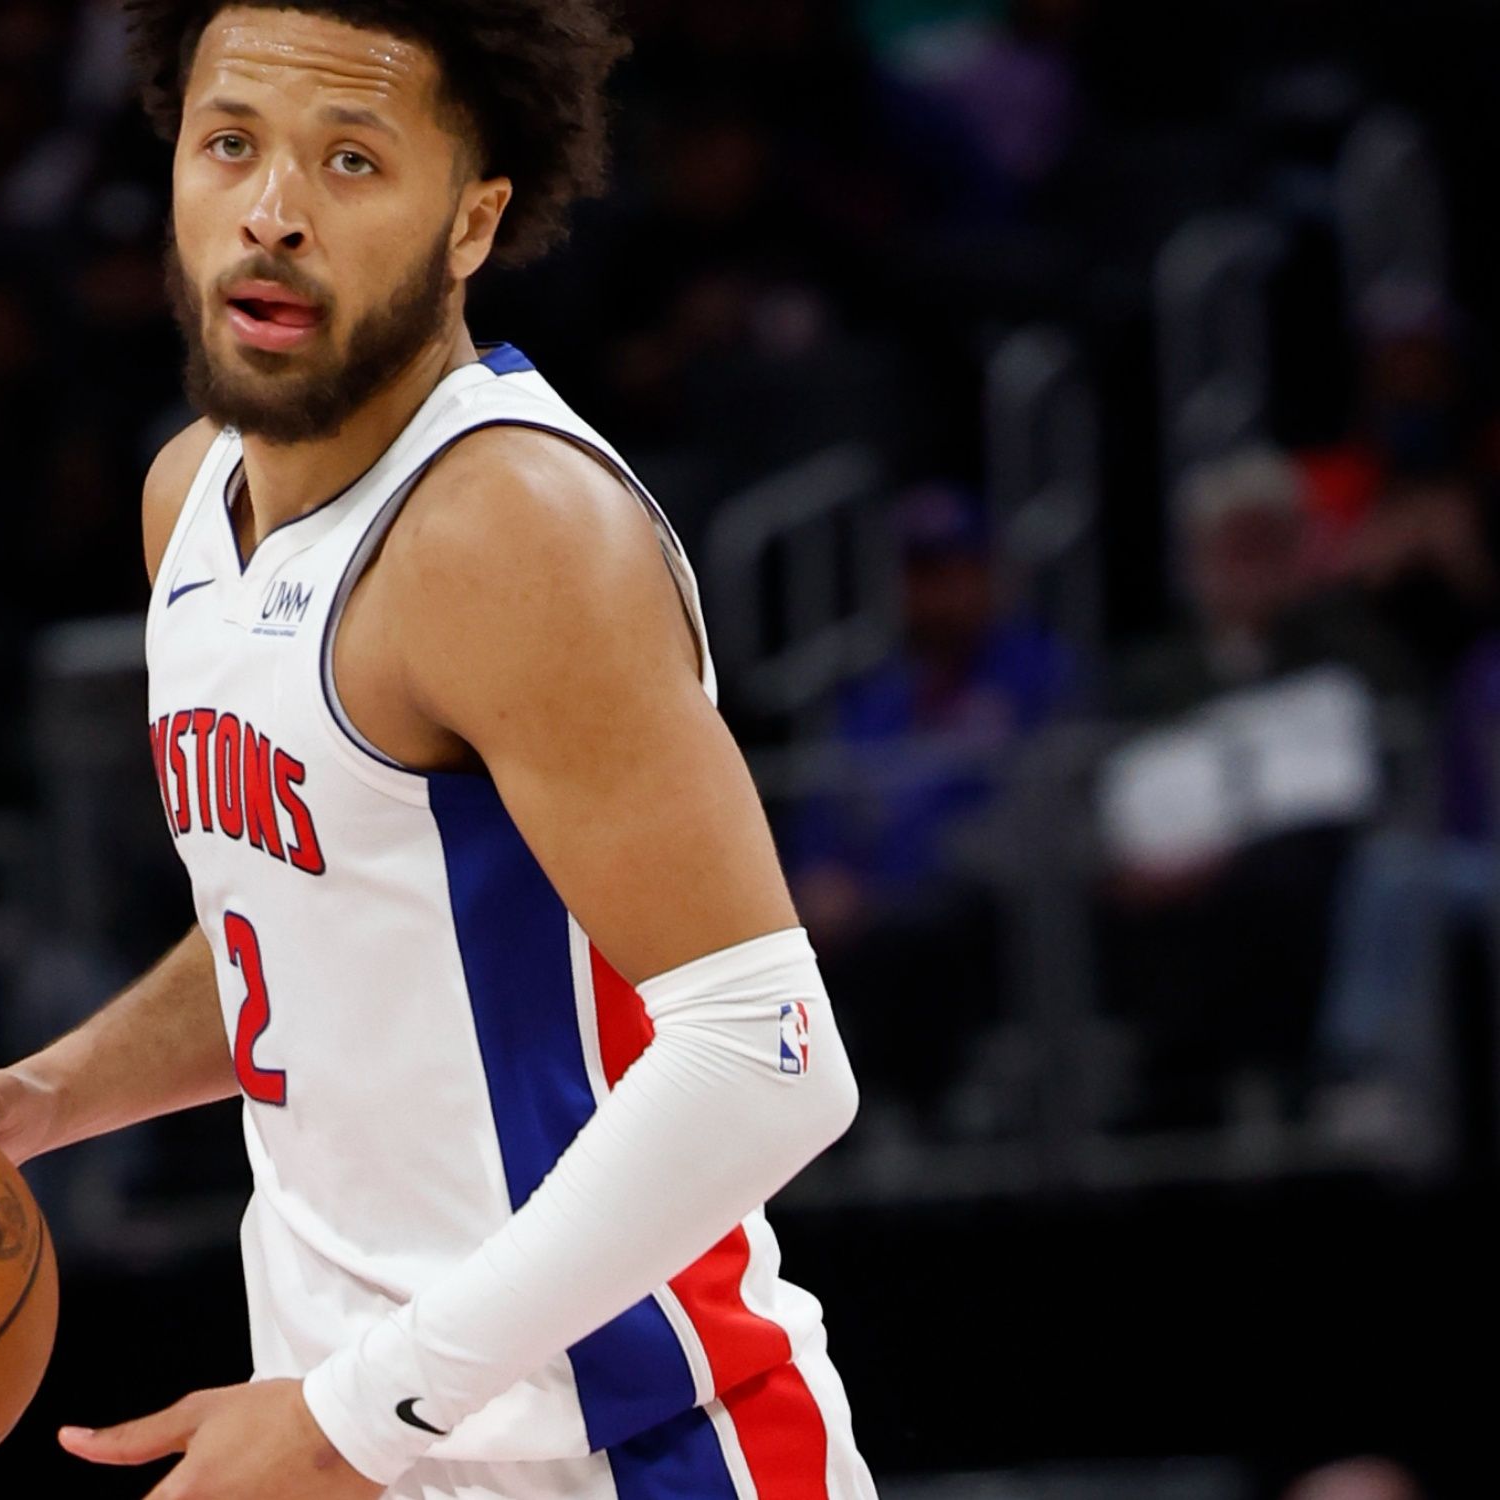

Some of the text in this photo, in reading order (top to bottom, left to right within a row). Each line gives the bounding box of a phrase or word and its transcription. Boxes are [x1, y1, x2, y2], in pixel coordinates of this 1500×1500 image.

[262, 581, 315, 622] UWM
[150, 708, 326, 876] ISTONS
[224, 910, 286, 1106] 2
